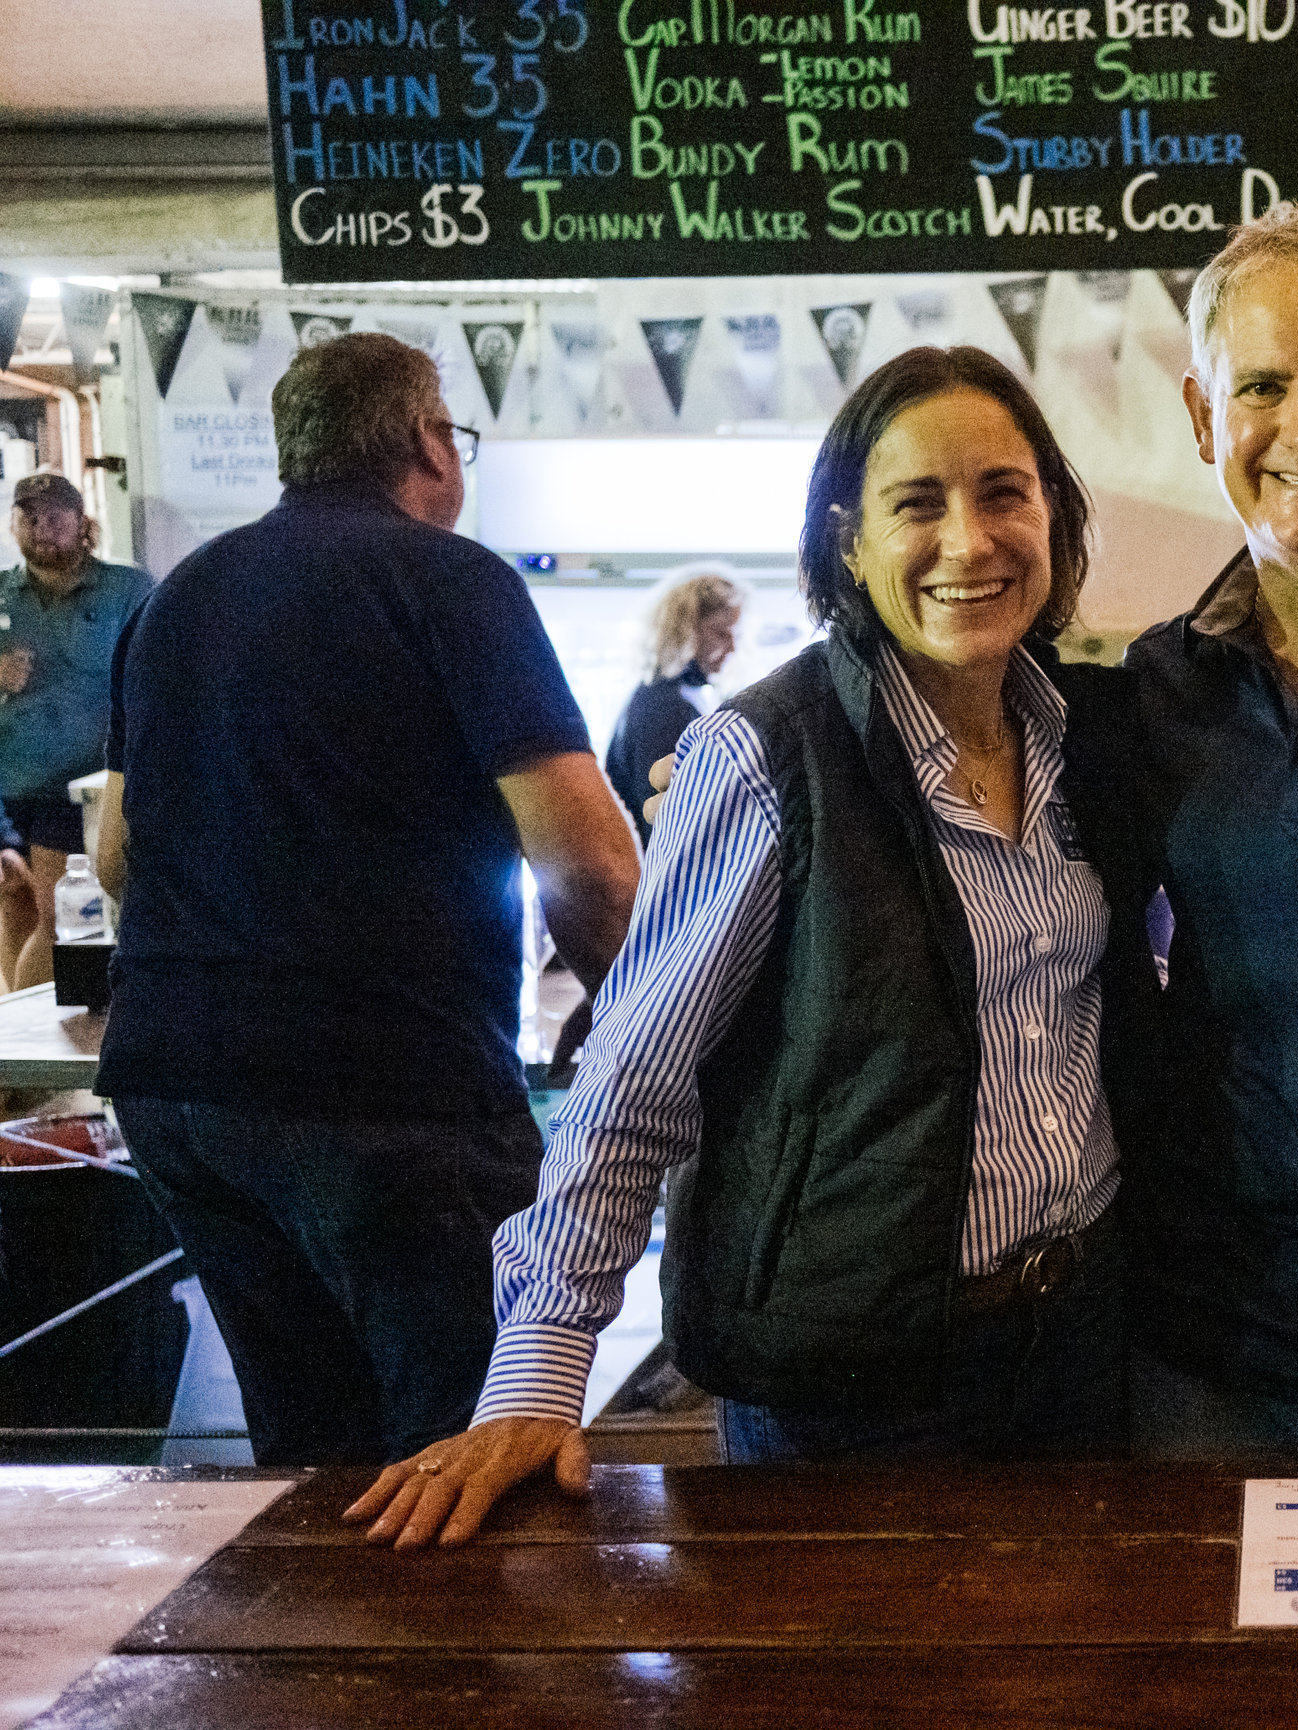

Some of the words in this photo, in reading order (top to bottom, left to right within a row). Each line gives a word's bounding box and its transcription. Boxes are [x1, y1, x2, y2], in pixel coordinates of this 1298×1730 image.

[1105, 0, 1195, 40] BEER
[277, 53, 441, 119] HAHN
[624, 48, 749, 111] VODKA
[973, 46, 1074, 106] JAMES
[1092, 41, 1220, 101] SQUIRE
[282, 121, 485, 183] HEINEKEN
[497, 120, 622, 178] ZERO
[630, 112, 766, 180] BUNDY
[970, 110, 1114, 175] STUBBY
[1120, 107, 1247, 166] HOLDER
[290, 186, 412, 247] CHIPS
[420, 183, 491, 248] $3
[521, 180, 664, 242] JOHNNY
[669, 179, 811, 241] WALKER
[825, 178, 973, 242] SCOTCH
[975, 173, 1119, 242] WATER,
[1121, 171, 1228, 232] COOL
